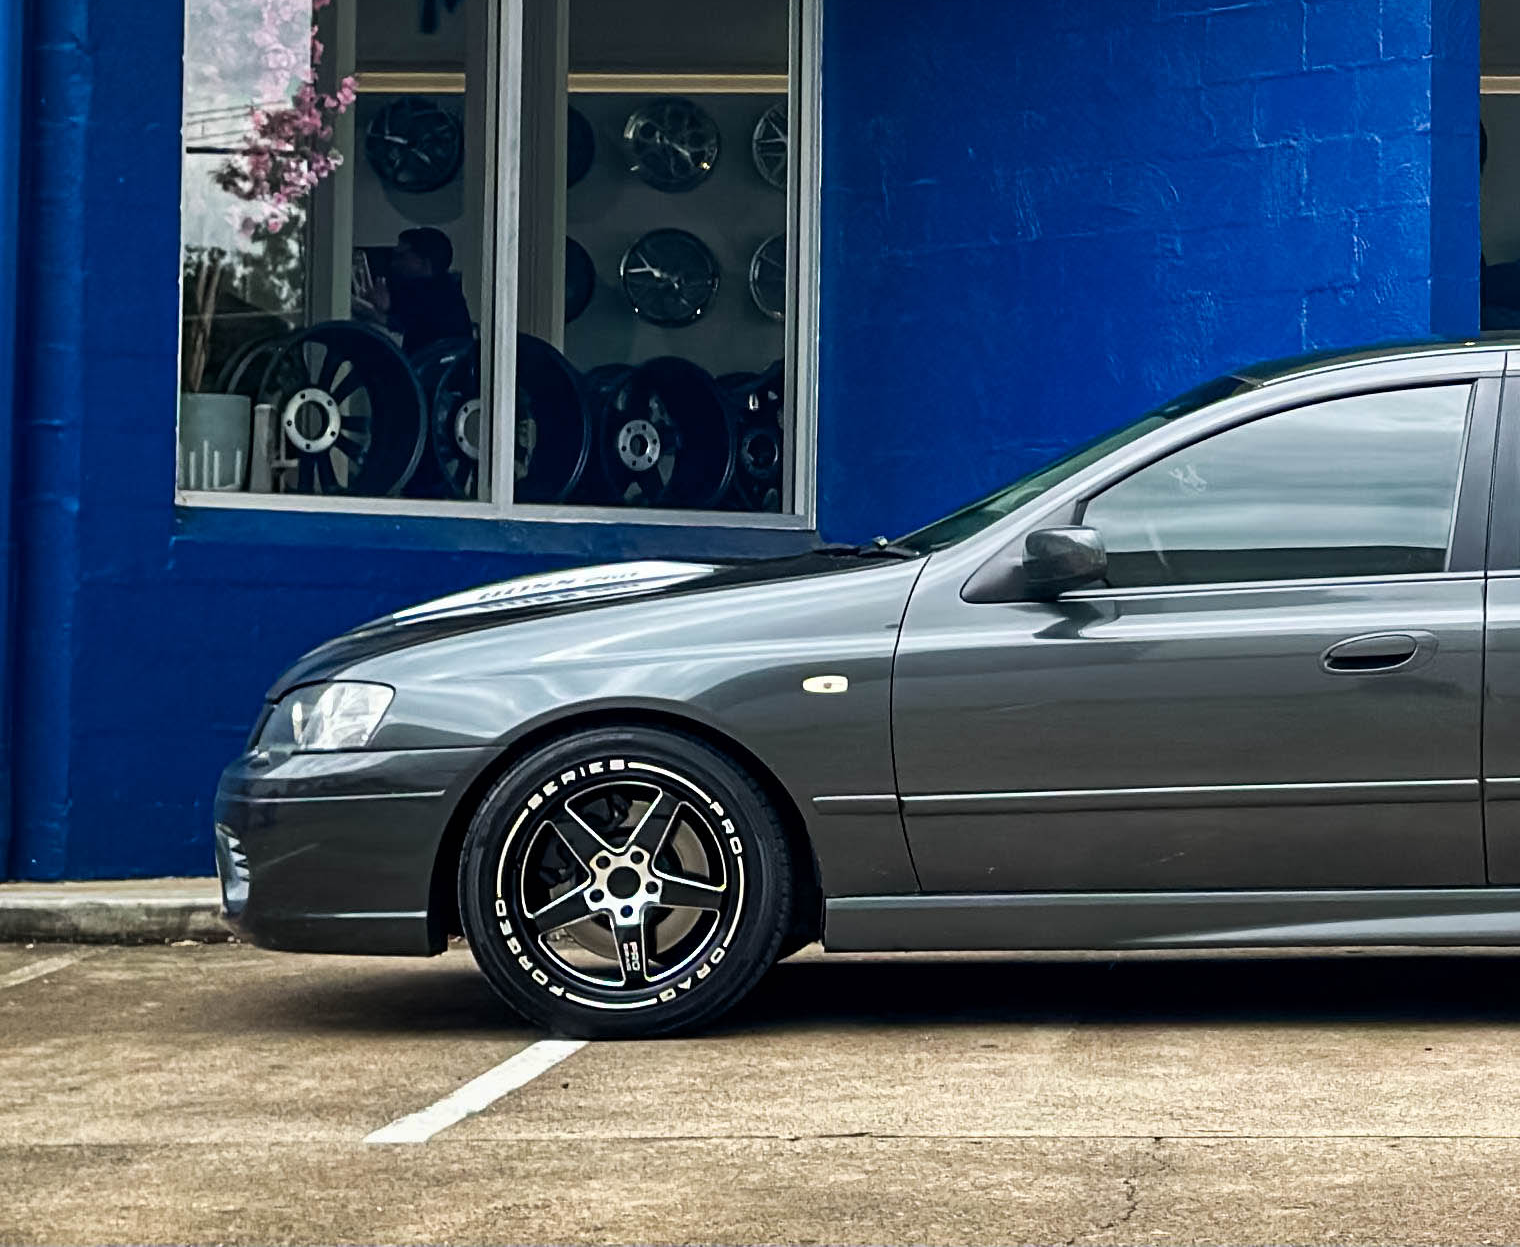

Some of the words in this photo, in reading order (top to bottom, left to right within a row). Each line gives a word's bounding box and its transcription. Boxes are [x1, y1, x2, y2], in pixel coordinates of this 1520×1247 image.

[527, 759, 625, 810] SERIES
[709, 801, 743, 855] PRO
[494, 899, 565, 997] FORGED
[629, 941, 641, 971] PRO
[658, 947, 726, 1003] DRAG
